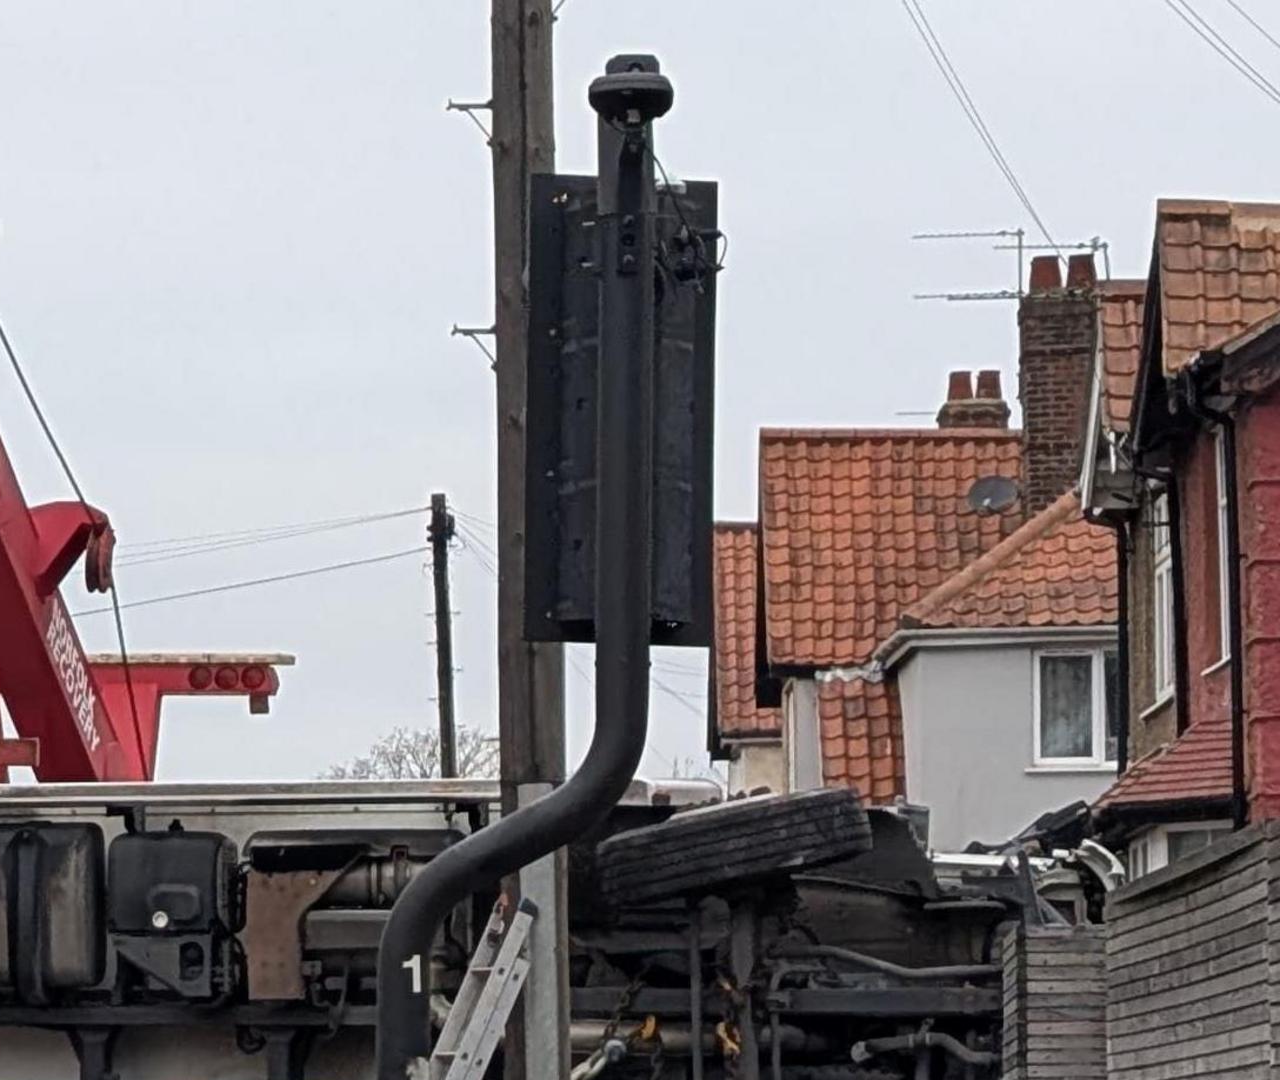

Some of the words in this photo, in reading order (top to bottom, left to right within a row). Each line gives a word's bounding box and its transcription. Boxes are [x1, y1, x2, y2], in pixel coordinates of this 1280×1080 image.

[46, 622, 101, 752] RECOVERY
[51, 598, 97, 720] NORFOLK
[402, 954, 421, 993] 1
